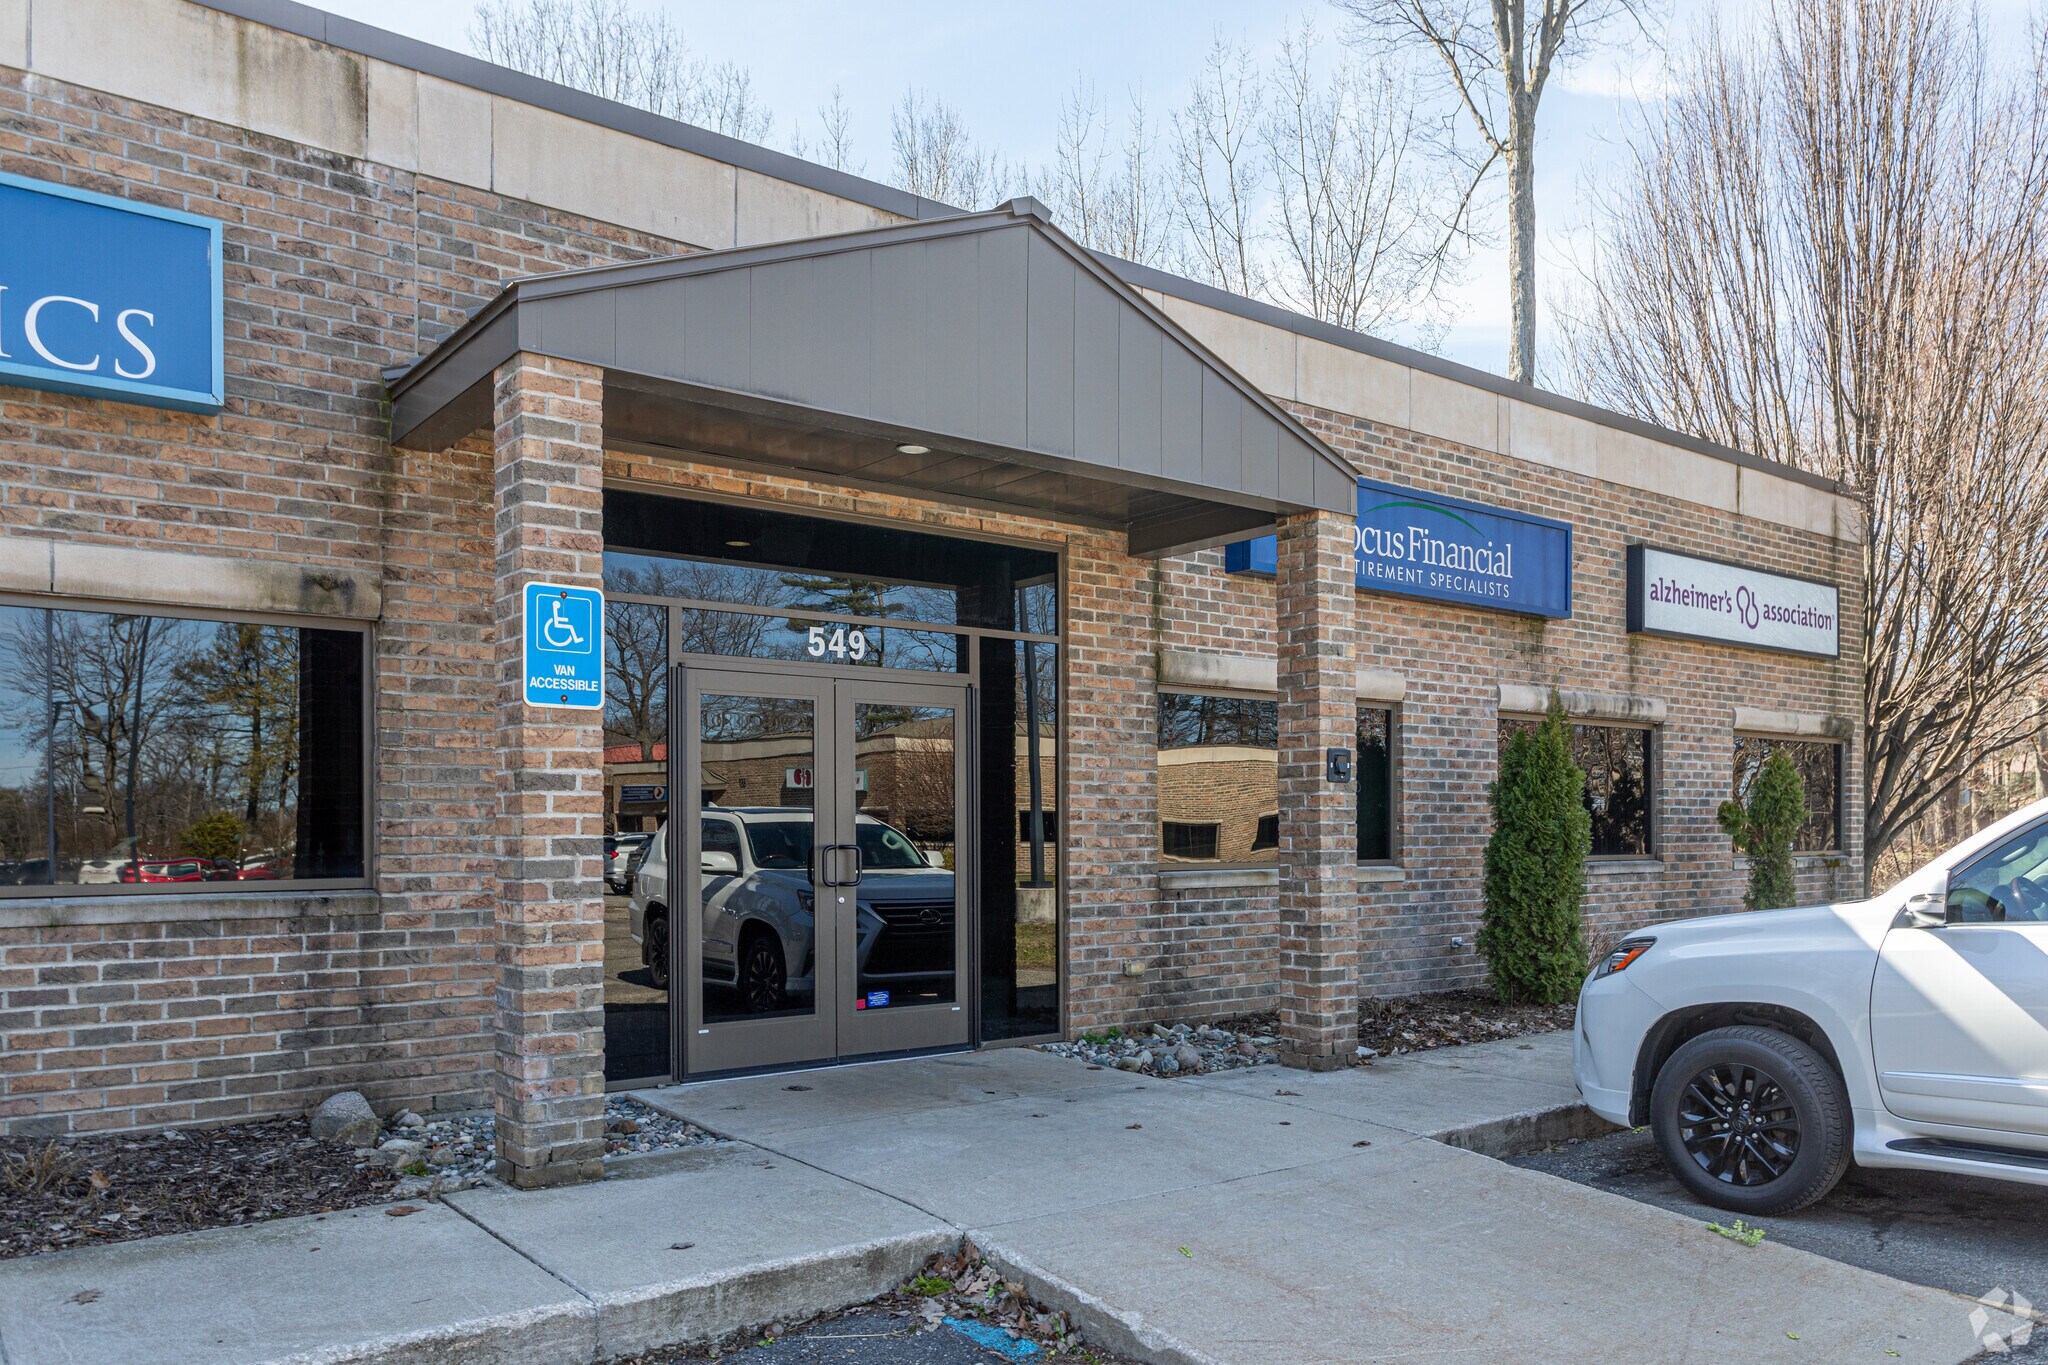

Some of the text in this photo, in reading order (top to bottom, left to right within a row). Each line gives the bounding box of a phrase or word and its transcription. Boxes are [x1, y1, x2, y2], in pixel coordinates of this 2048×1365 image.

[1354, 525, 1513, 579] ocus Financial
[1354, 559, 1510, 598] TIREMENT SPECIALISTS
[1650, 577, 1832, 630] alzheimer's association
[807, 626, 866, 660] 549
[529, 677, 599, 692] ACCESSIBLE
[553, 664, 575, 676] VAN
